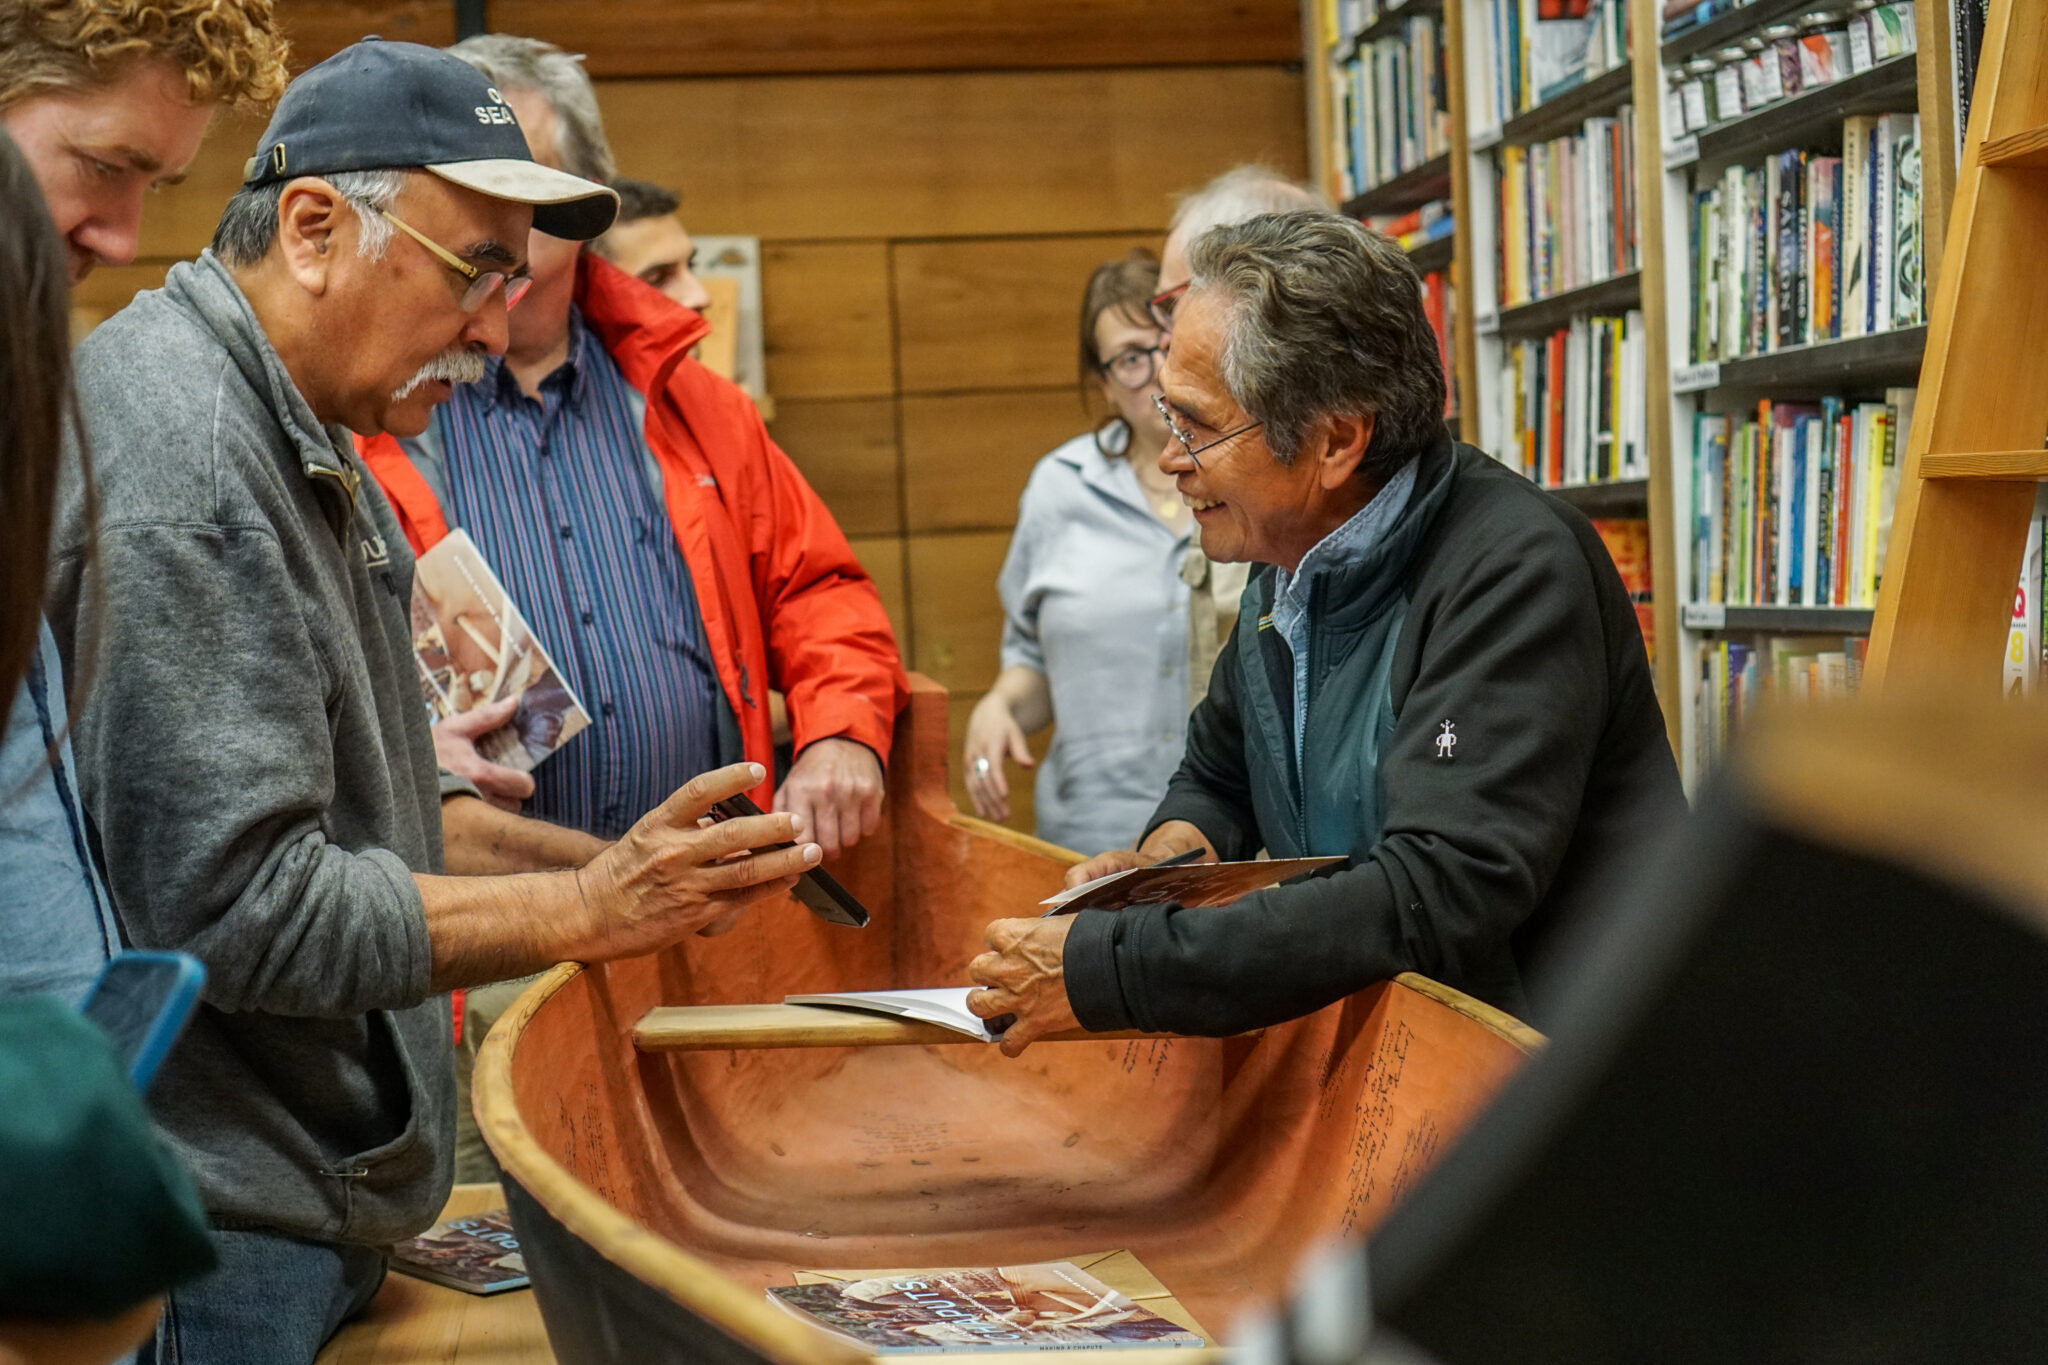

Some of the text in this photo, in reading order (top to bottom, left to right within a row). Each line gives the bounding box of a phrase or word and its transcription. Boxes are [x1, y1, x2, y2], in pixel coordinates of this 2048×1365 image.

[487, 87, 512, 108] O
[1780, 190, 1792, 311] SALMON
[892, 1280, 1021, 1340] CHAPUTS
